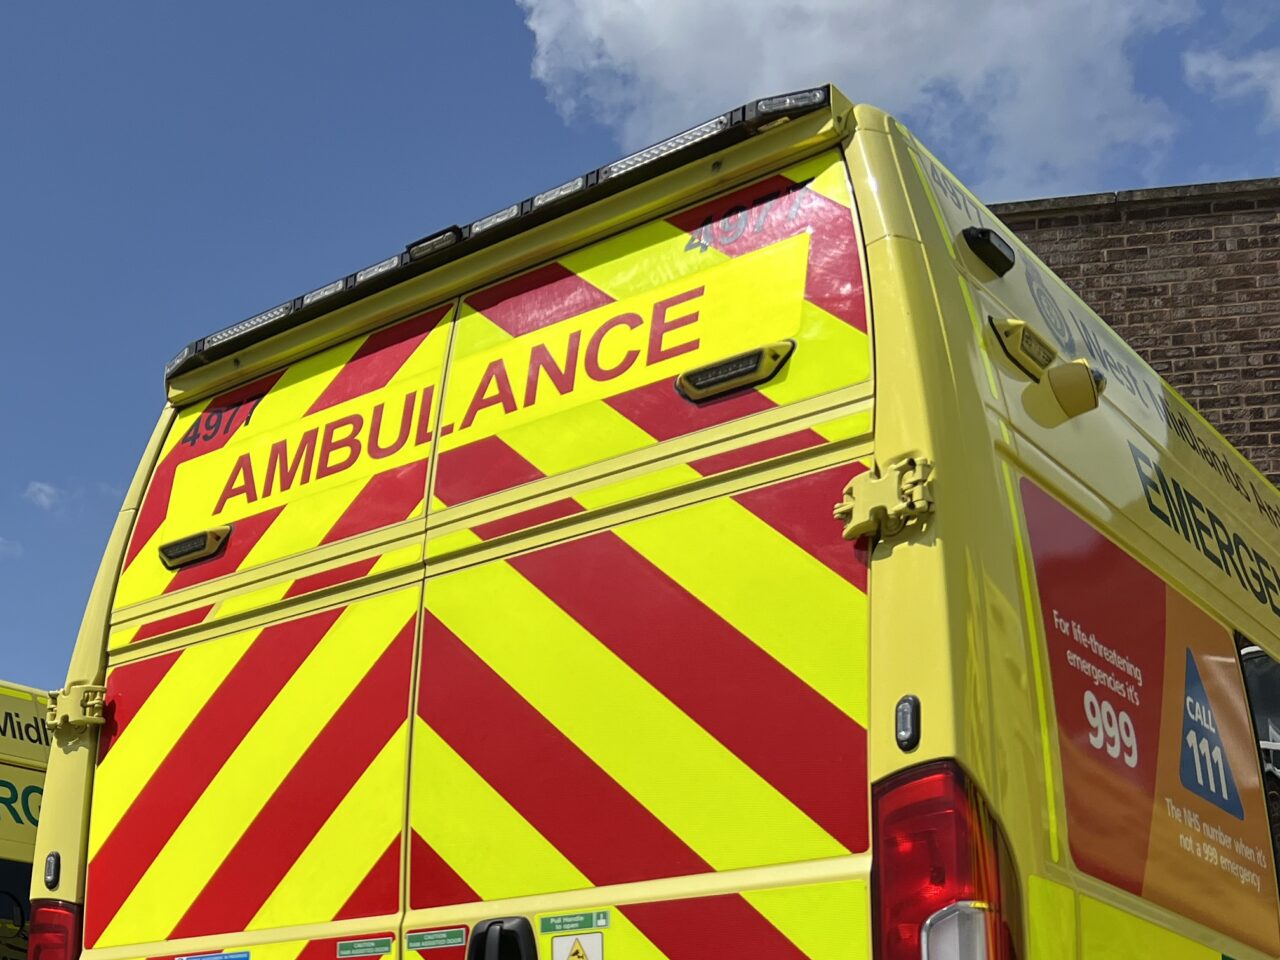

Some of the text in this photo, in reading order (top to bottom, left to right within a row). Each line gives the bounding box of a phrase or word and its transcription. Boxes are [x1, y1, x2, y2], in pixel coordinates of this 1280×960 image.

[684, 176, 815, 252] 4977
[181, 393, 265, 446] 4977
[213, 285, 705, 515] AMBULANCE
[1068, 307, 1149, 408] West
[1142, 379, 1251, 503] Midlands
[1127, 439, 1280, 618] EMERGE
[1052, 609, 1143, 687] For life-threatening
[1066, 650, 1126, 698] emergencies
[1084, 690, 1138, 768] 999
[1186, 696, 1216, 734] CALL
[1186, 729, 1228, 800] 111
[1165, 797, 1181, 822] The
[1183, 808, 1200, 832] NHS
[1202, 822, 1232, 849] number
[1234, 838, 1255, 863] when
[1180, 833, 1194, 854] not
[1220, 855, 1260, 893] emergency
